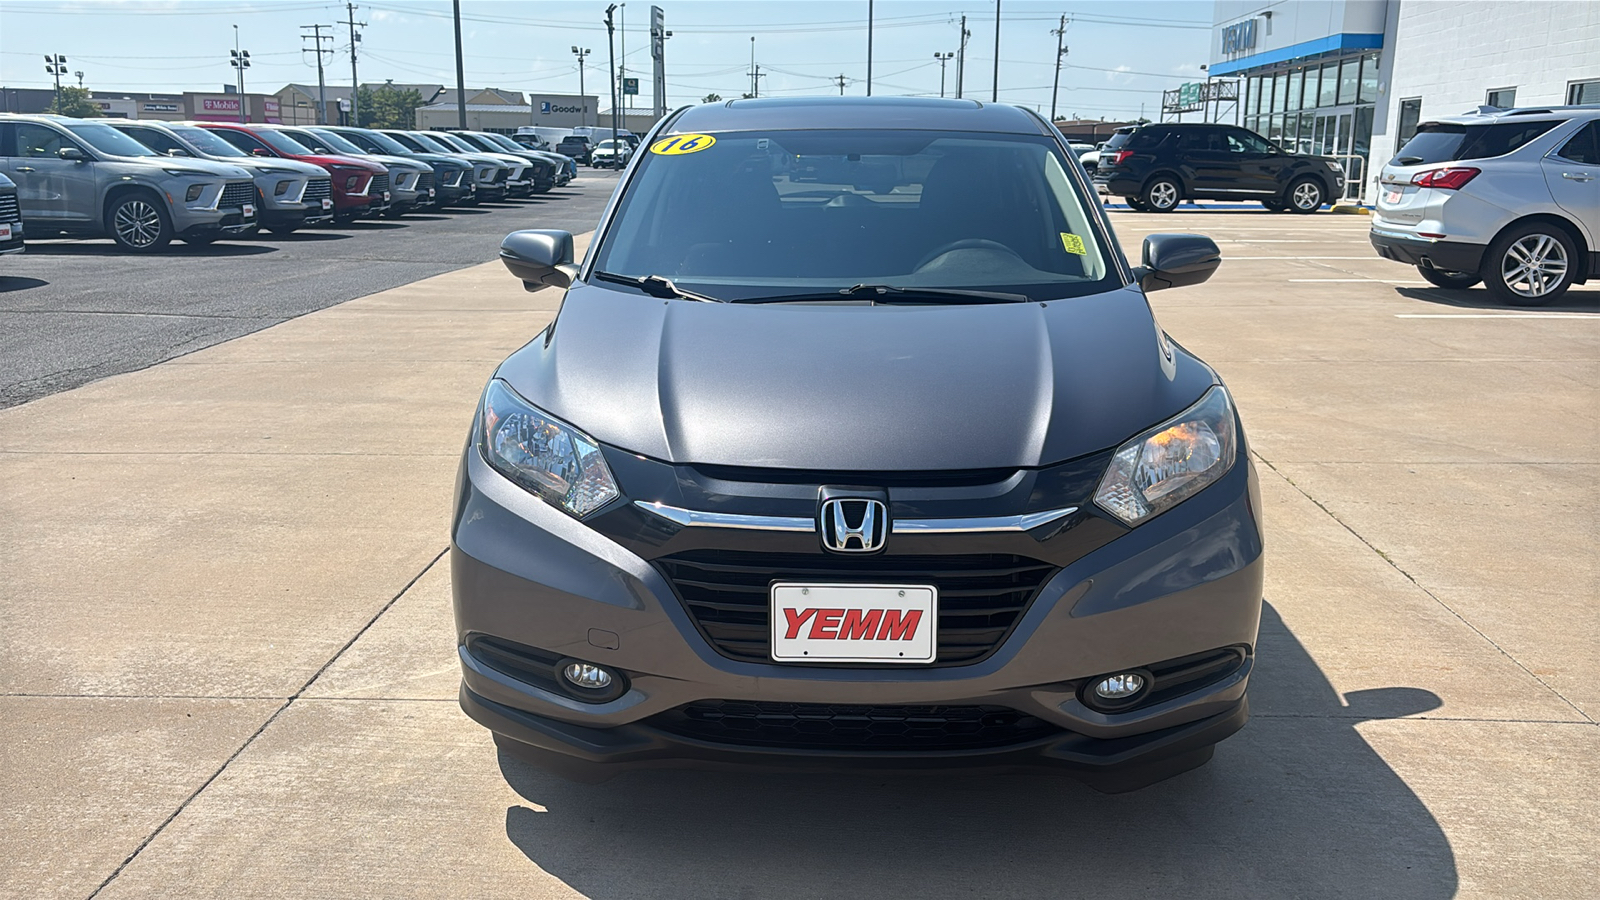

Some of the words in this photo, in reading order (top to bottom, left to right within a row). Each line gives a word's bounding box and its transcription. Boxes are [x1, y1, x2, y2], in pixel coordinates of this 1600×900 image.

[551, 105, 588, 113] Goodwll
[661, 137, 703, 152] 16
[783, 608, 924, 641] YEMM
